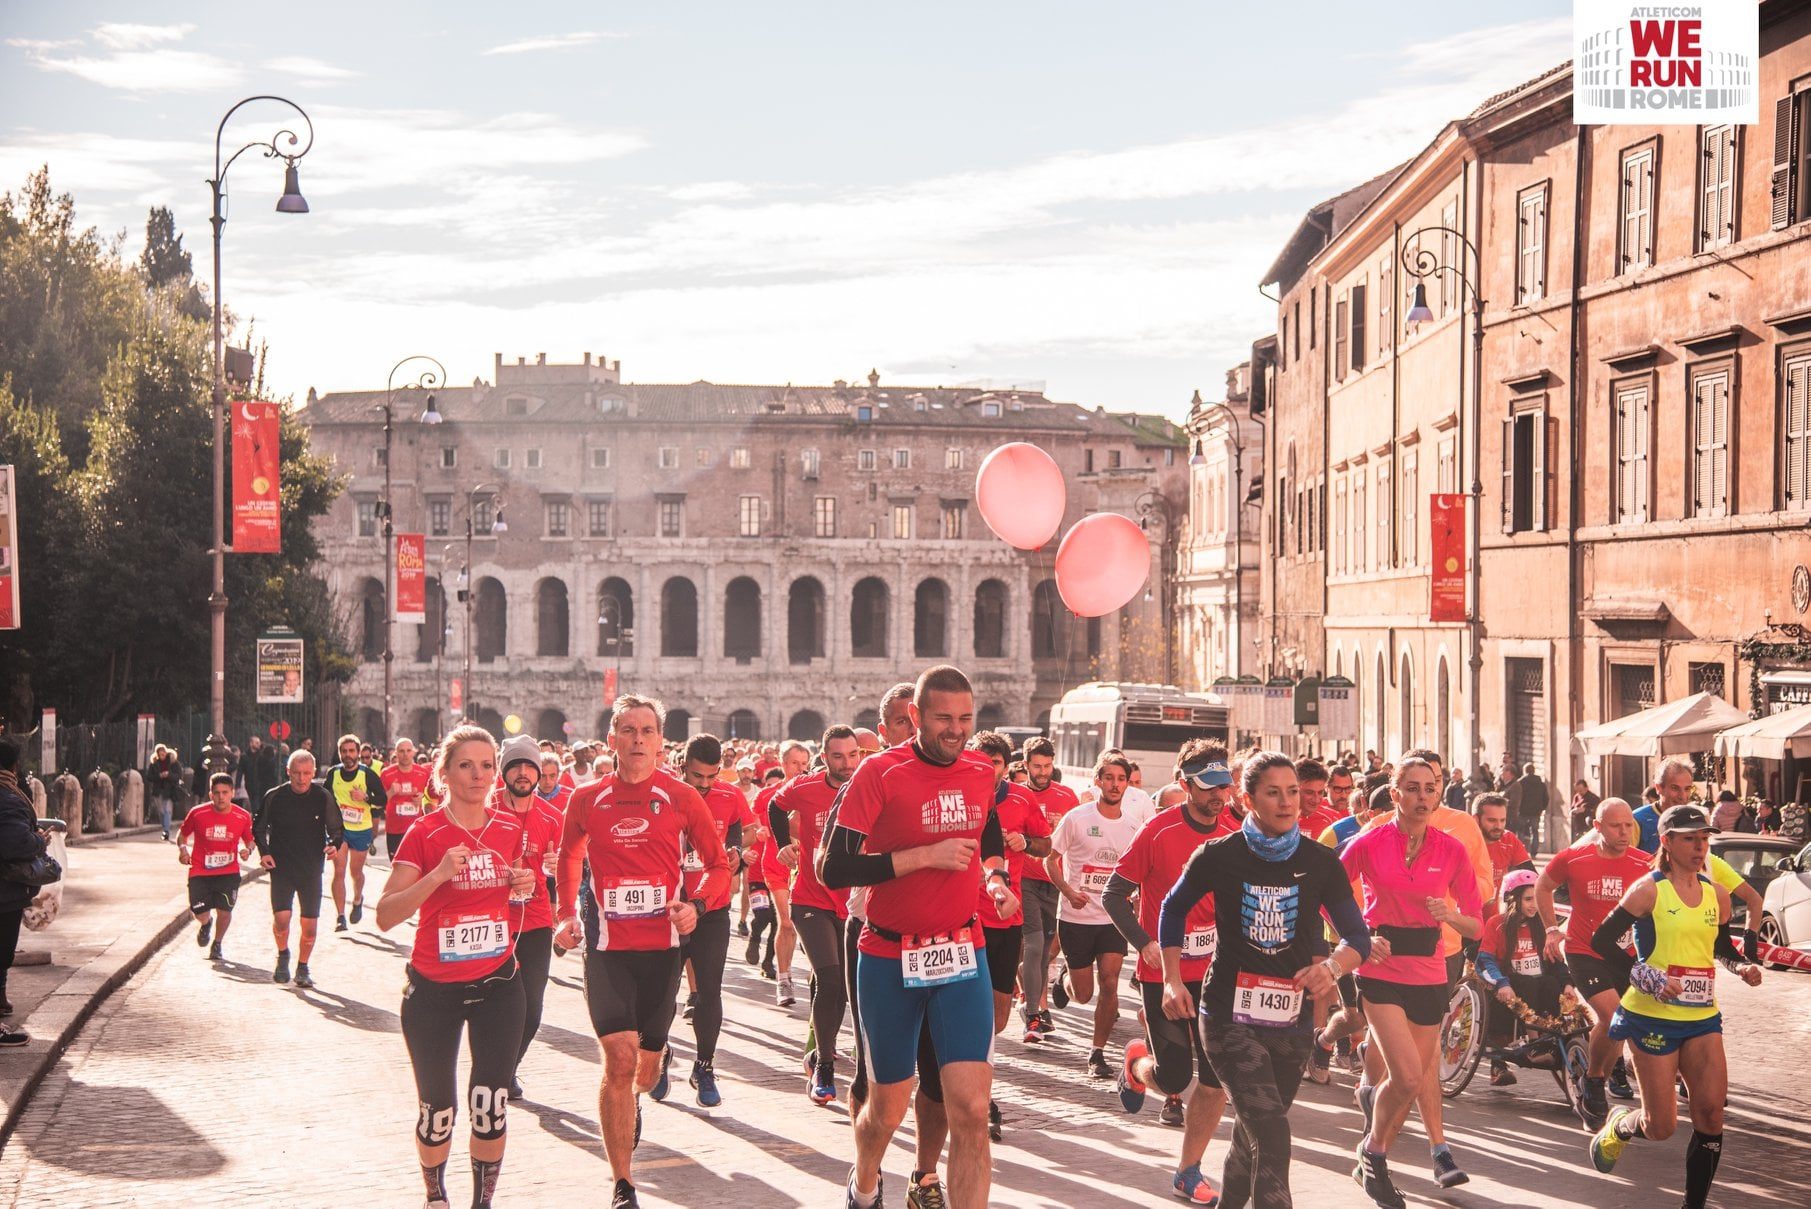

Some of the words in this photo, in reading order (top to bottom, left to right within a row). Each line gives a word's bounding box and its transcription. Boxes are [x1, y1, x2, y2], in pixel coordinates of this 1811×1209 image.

[399, 553, 424, 569] ROMA
[939, 795, 966, 811] WE
[941, 810, 967, 824] RUN
[941, 822, 967, 833] ROME
[469, 854, 494, 870] WE
[470, 868, 496, 881] RUN
[1093, 874, 1110, 884] 609
[471, 879, 497, 889] ROME
[1250, 885, 1291, 896] ATLETICOM
[1602, 879, 1622, 889] WE
[625, 890, 644, 903] 491
[1602, 888, 1622, 898] RUN
[1258, 895, 1281, 912] WE
[1254, 911, 1285, 927] RUN
[461, 925, 489, 944] 2177
[1195, 932, 1215, 947] 1884
[1249, 926, 1288, 943] ROME
[1518, 940, 1533, 950] WE
[923, 947, 954, 968] 2204
[1684, 979, 1707, 993] 2094
[1259, 992, 1291, 1010] 1430
